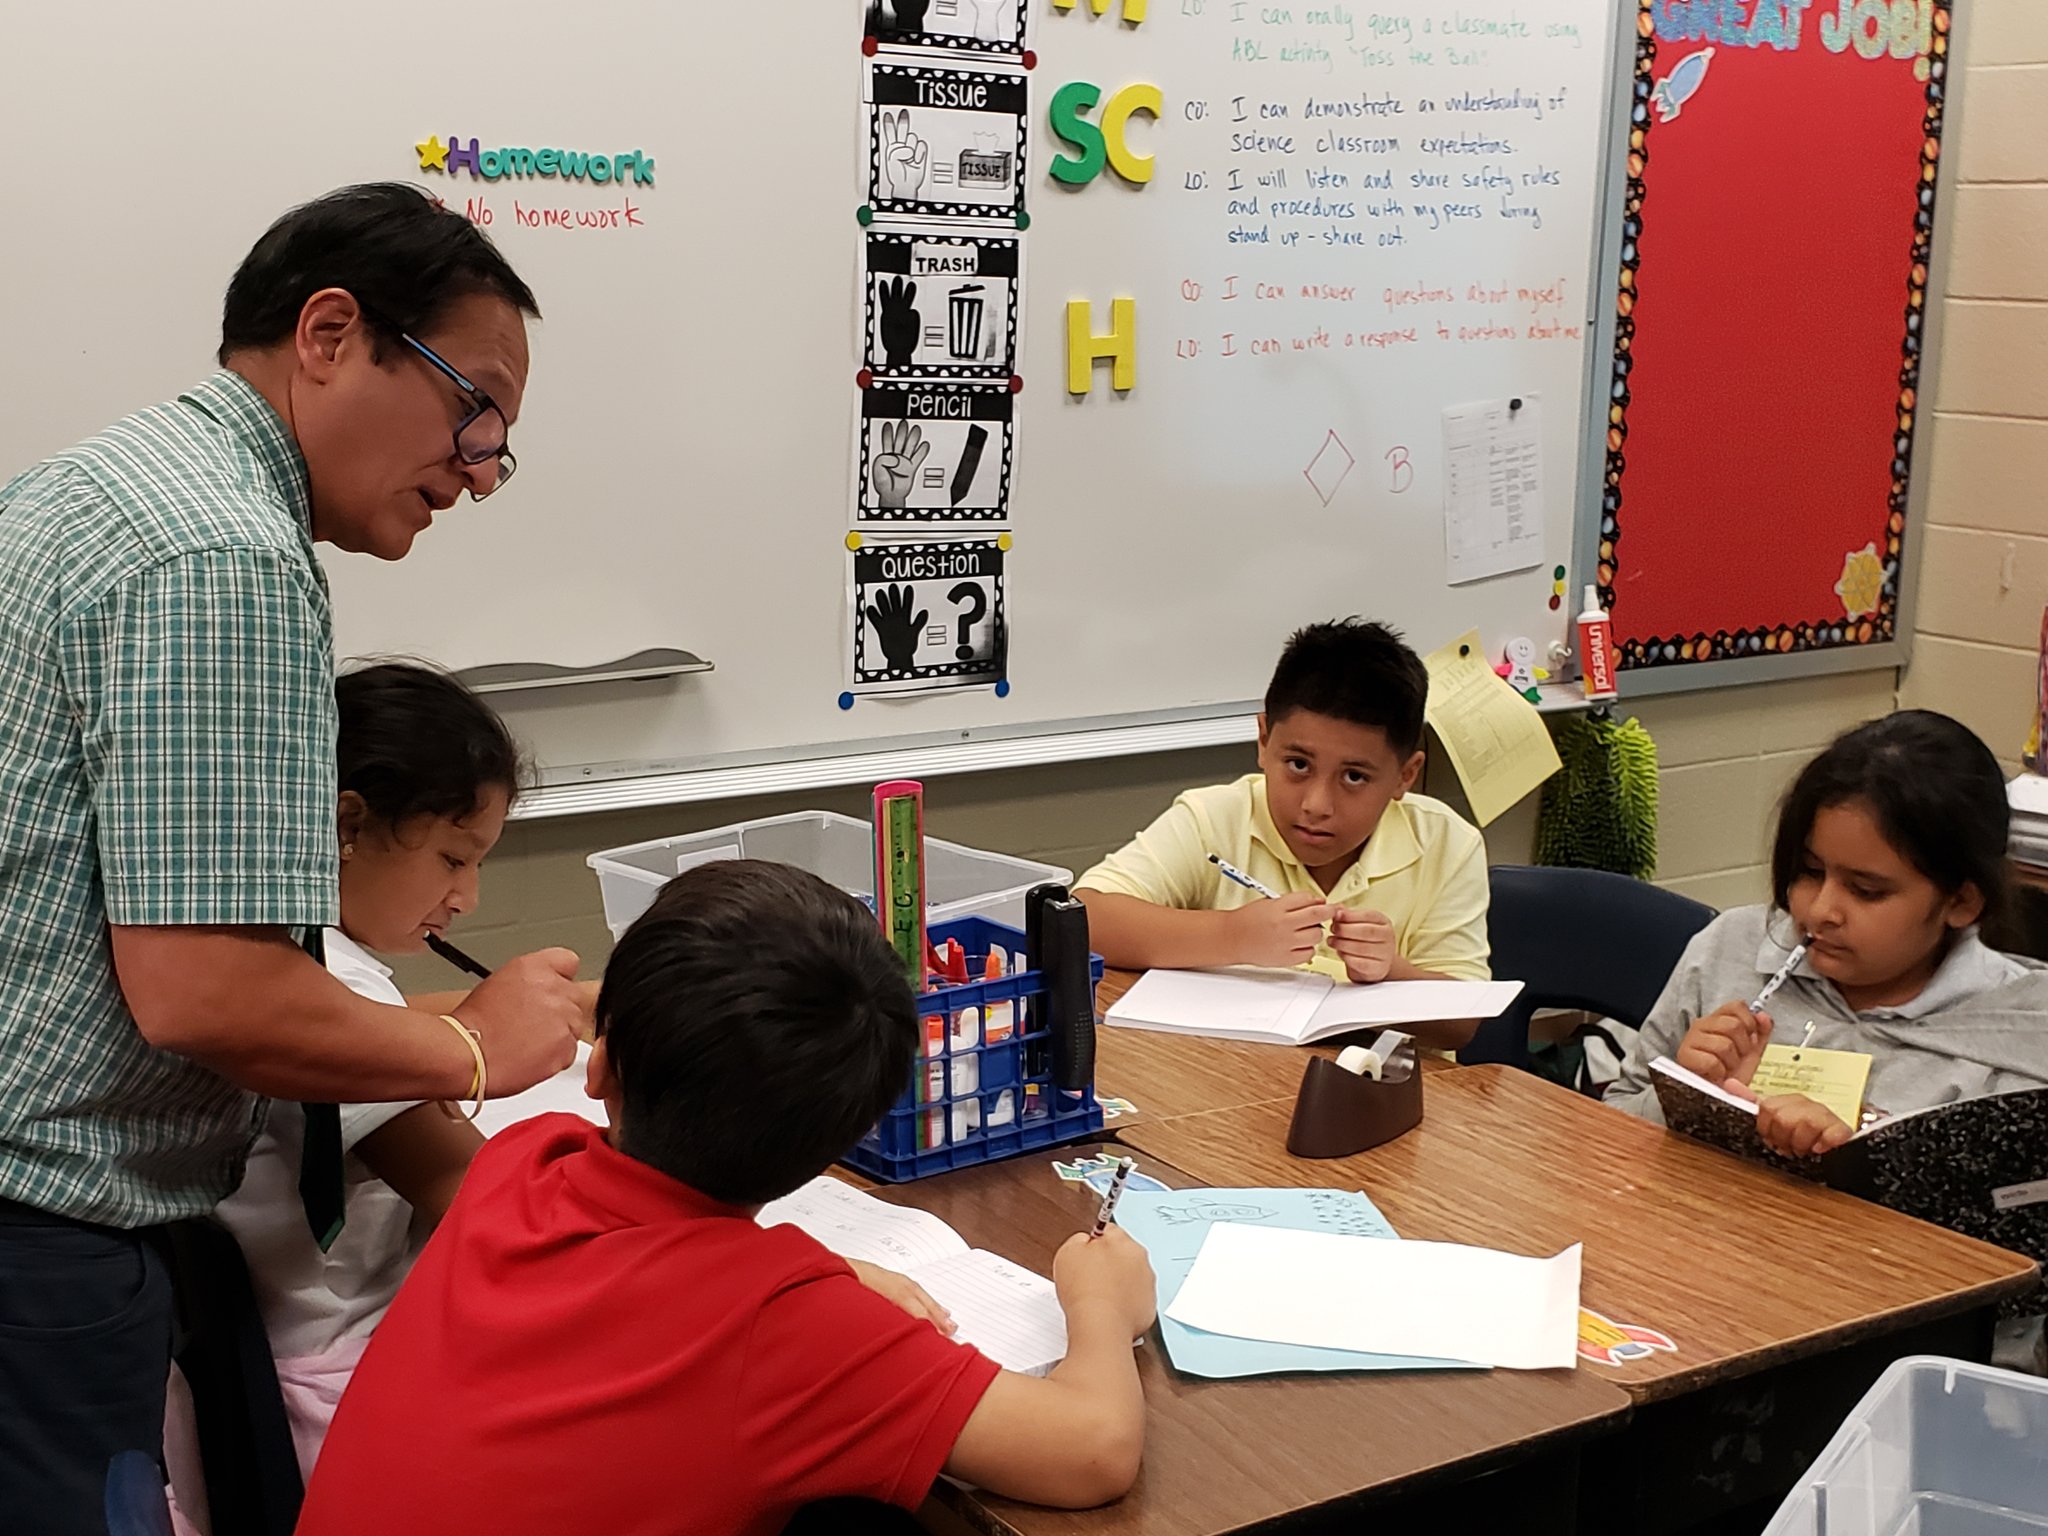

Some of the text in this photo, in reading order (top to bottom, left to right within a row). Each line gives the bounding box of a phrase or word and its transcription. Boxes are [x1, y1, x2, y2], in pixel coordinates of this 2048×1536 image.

[1231, 2, 1248, 22] I
[1261, 8, 1293, 25] can
[1306, 5, 1355, 42] orally
[1367, 13, 1413, 44] query
[1423, 18, 1432, 34] a
[1442, 9, 1531, 38] classmate
[1545, 22, 1582, 48] using
[1652, 0, 1812, 50] GREAT
[1409, 44, 1435, 66] the
[914, 79, 988, 108] Tissue
[1231, 96, 1248, 122] I
[1260, 103, 1289, 120] can
[1304, 92, 1405, 119] demonstrate
[1419, 99, 1435, 114] an
[1445, 87, 1543, 121] understanding
[1549, 86, 1567, 110] of
[1050, 82, 1163, 184] SC
[1316, 130, 1400, 154] classroom
[1420, 131, 1519, 158] expectations.
[448, 136, 655, 185] Homework
[961, 162, 1001, 178] TISSUE
[1228, 168, 1244, 191] I
[1257, 168, 1287, 188] will
[1306, 166, 1348, 189] listen
[1364, 168, 1393, 189] and
[1410, 169, 1449, 188] share
[1463, 165, 1514, 196] safety
[1522, 165, 1560, 186] rules
[467, 196, 645, 230] No homework
[1227, 196, 1260, 215] and
[1271, 197, 1356, 219] procedures
[1367, 198, 1404, 217] with
[1414, 204, 1439, 230] my
[1443, 203, 1482, 223] peers
[1228, 225, 1270, 244] stand
[1281, 231, 1299, 247] up
[1323, 225, 1365, 245] share
[915, 256, 976, 273] TRASH
[1221, 276, 1239, 300] I
[1300, 284, 1356, 301] answer
[1384, 281, 1454, 314] questions
[1468, 279, 1509, 304] about
[1517, 278, 1567, 314] myself
[1067, 298, 1135, 394] H
[1221, 333, 1238, 357] I
[1251, 339, 1281, 356] can
[1292, 326, 1329, 350] write
[1344, 333, 1353, 346] a
[1360, 327, 1418, 349] response
[1437, 320, 1449, 340] to
[1459, 319, 1517, 343] questions
[1527, 318, 1561, 339] about
[1564, 327, 1582, 339] me
[882, 553, 980, 579] Question
